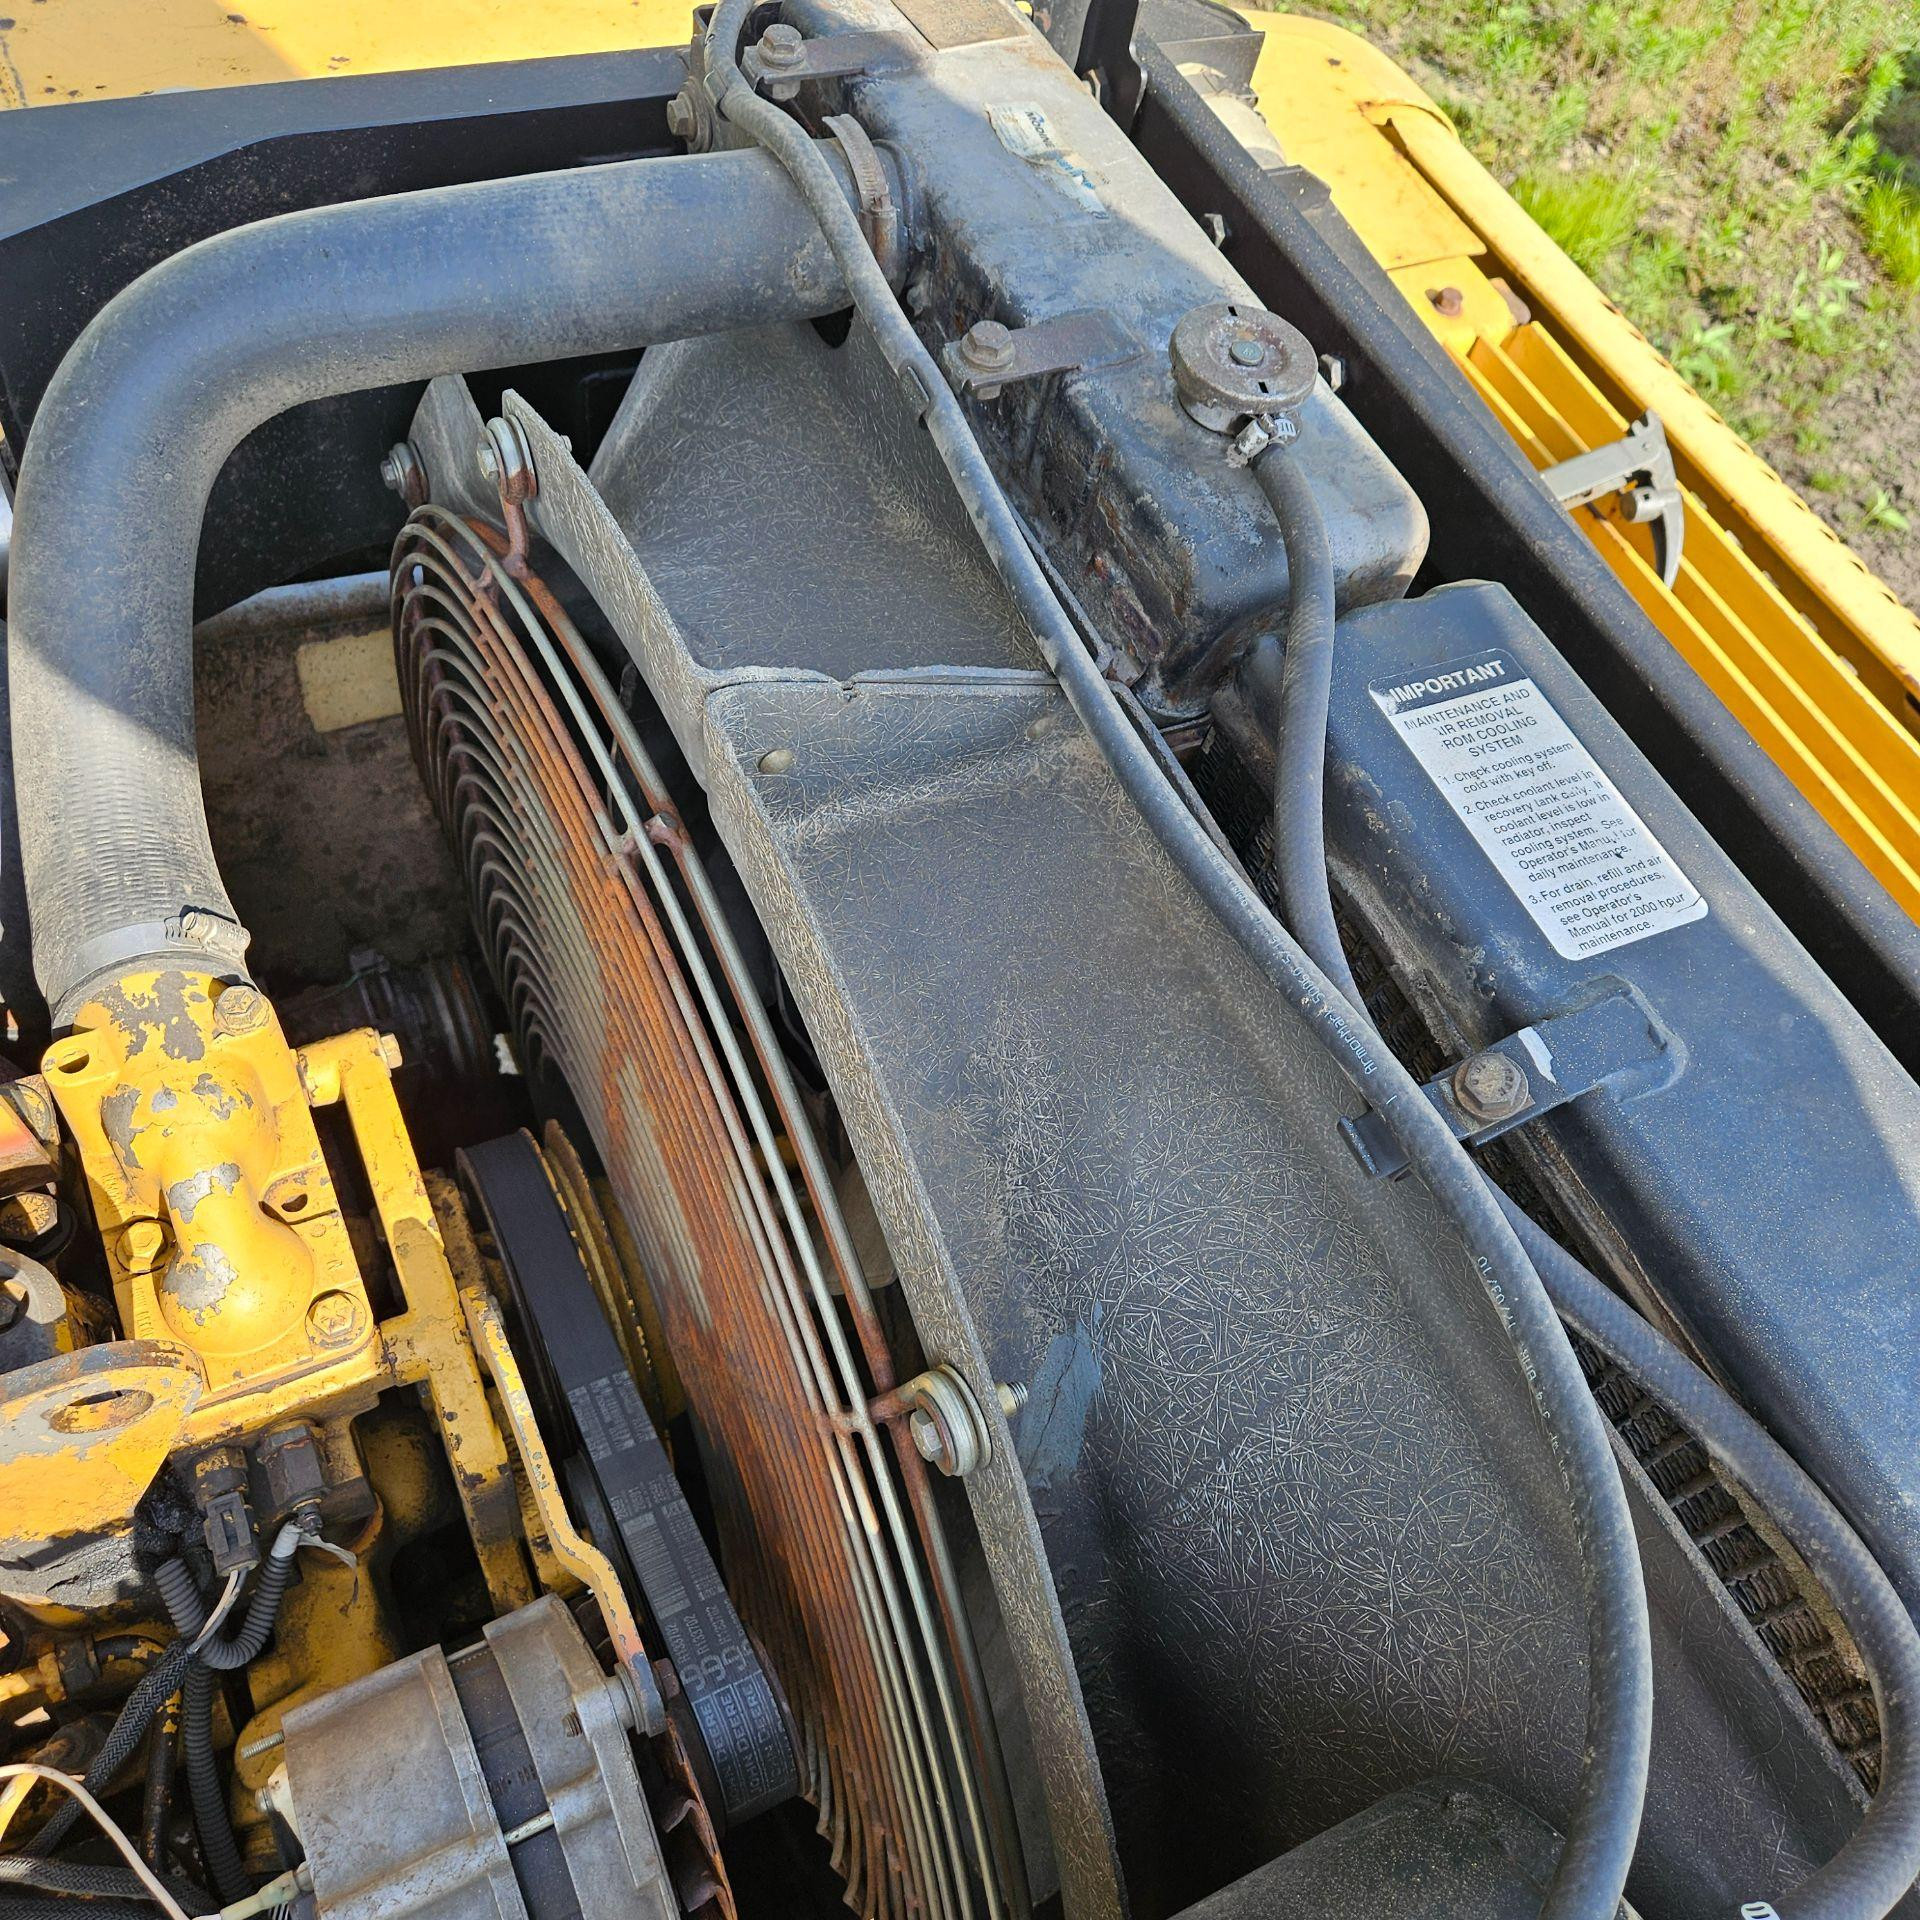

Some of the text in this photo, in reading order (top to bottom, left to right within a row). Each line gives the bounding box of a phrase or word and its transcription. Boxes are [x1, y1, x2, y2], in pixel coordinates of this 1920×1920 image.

[1389, 660, 1505, 703] IMPORTANT
[1403, 688, 1530, 730] MAINTENANCE AND
[1456, 706, 1523, 730] REMOVAL
[1442, 716, 1537, 749] ROM COOLING
[1468, 734, 1524, 757] SYSTEM
[1454, 765, 1491, 782] Check
[1491, 754, 1534, 772] cooling
[1533, 743, 1573, 759] system
[1463, 761, 1556, 794] cold with key off.
[1463, 770, 1594, 815] 2. Check coolant level in
[1484, 802, 1533, 822] recovery
[1493, 794, 1610, 834] coolant level is low in
[1501, 812, 1592, 846] radiator, inspect
[1510, 818, 1624, 858] cooling system. See
[1518, 846, 1579, 870] Operator's
[1528, 846, 1632, 882] daily maintenance.
[1528, 894, 1542, 904] 3.
[1539, 888, 1561, 901] For
[1563, 879, 1597, 893] drain,
[1597, 867, 1624, 883] refill
[1624, 859, 1646, 874] and
[1550, 872, 1665, 913] removal procedures,
[1560, 893, 1642, 925] see Operator's
[1567, 917, 1612, 938] Manual
[1629, 901, 1658, 918] 2000
[1657, 893, 1685, 908] hour
[1578, 921, 1655, 951] maintenance.
[1293, 966, 1325, 1003] 50060
[1325, 1007, 1378, 1074] ArmorMark
[667, 1623, 691, 1664] R133702
[685, 1613, 710, 1654] R133702
[700, 1703, 729, 1763] DEERE
[721, 1694, 751, 1752] DEERE
[742, 1683, 772, 1743] DEERE
[741, 1752, 763, 1795] JOHN
